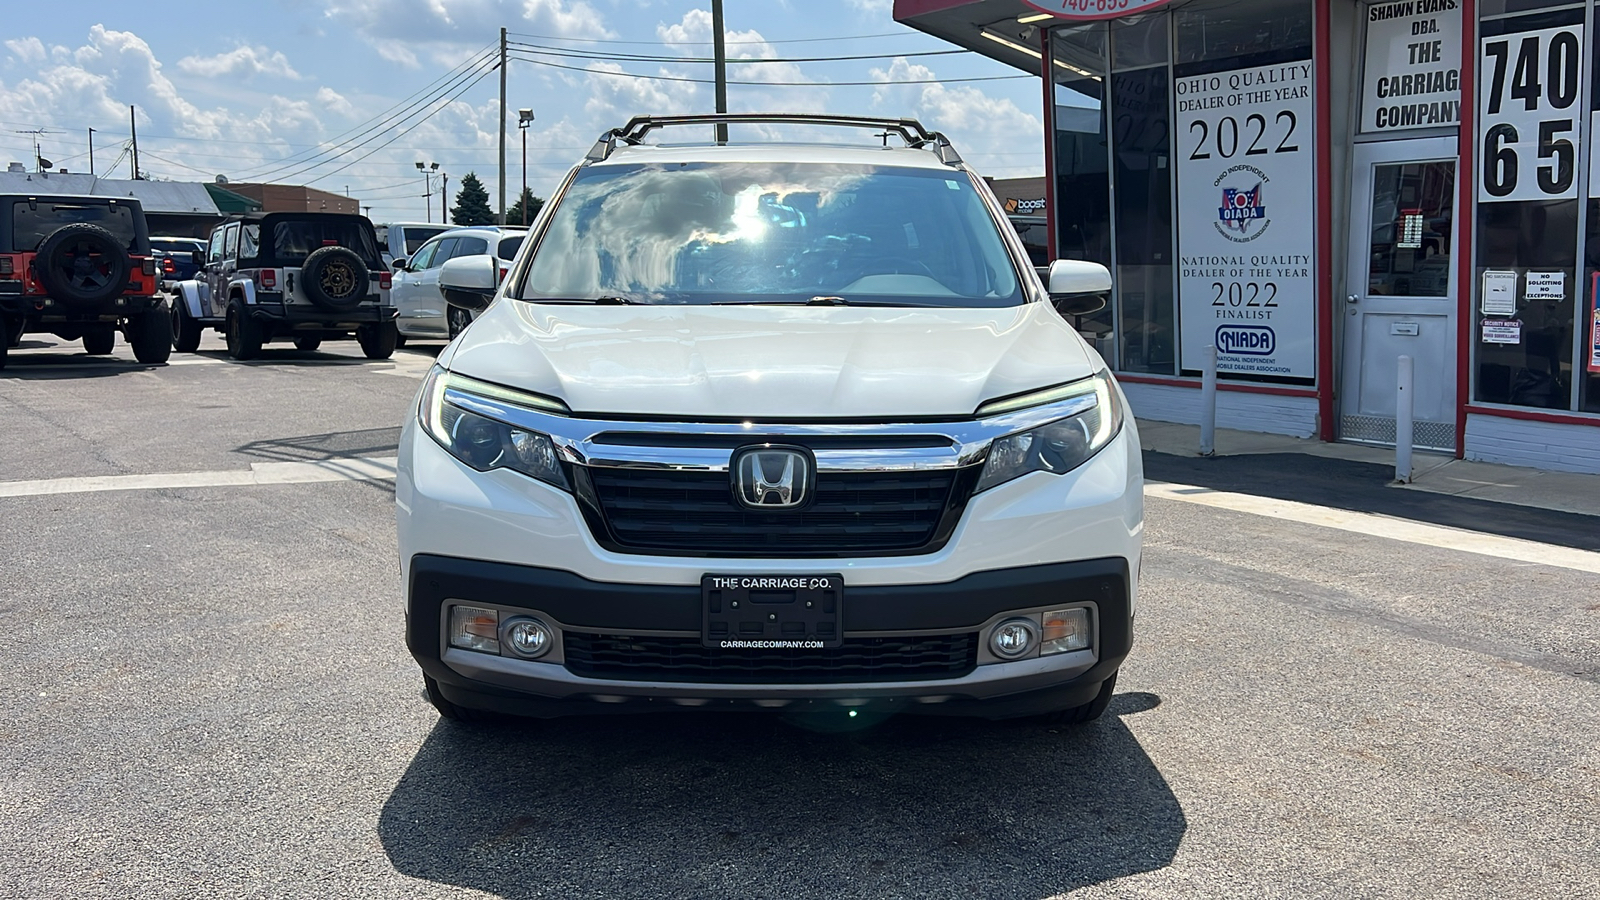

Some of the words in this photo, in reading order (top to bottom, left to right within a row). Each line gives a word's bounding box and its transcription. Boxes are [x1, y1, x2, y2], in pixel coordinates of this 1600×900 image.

[1369, 2, 1413, 22] SHAWN
[1411, 18, 1440, 36] DBA.
[1407, 40, 1442, 65] THE
[1177, 76, 1221, 95] OHIO
[1229, 64, 1311, 90] QUALITY
[1485, 31, 1579, 115] 740
[1377, 69, 1462, 99] CARRIAG
[1179, 96, 1224, 113] DEALER
[1227, 94, 1244, 107] OF
[1246, 90, 1271, 104] THE
[1274, 85, 1309, 101] YEAR
[1189, 110, 1299, 161] 2022
[1213, 171, 1228, 187] OHIO
[1227, 165, 1270, 184] INDEPENDENT
[1018, 198, 1046, 209] boost
[1224, 208, 1258, 219] OIADA
[1182, 256, 1246, 266] NATIONAL
[1250, 255, 1311, 267] QUALITY
[1183, 268, 1225, 278] DEALER
[1230, 268, 1244, 277] OF
[1249, 268, 1272, 277] THE
[1276, 268, 1309, 277] YEAR
[1211, 281, 1279, 308] 2022
[1216, 309, 1273, 320] FINALIST
[1219, 330, 1270, 352] NIADA
[713, 578, 739, 588] THE
[741, 578, 808, 588] CARRIAGE
[809, 578, 832, 588] CO.
[720, 640, 824, 649] CARRIAGECOMPANY.COM
